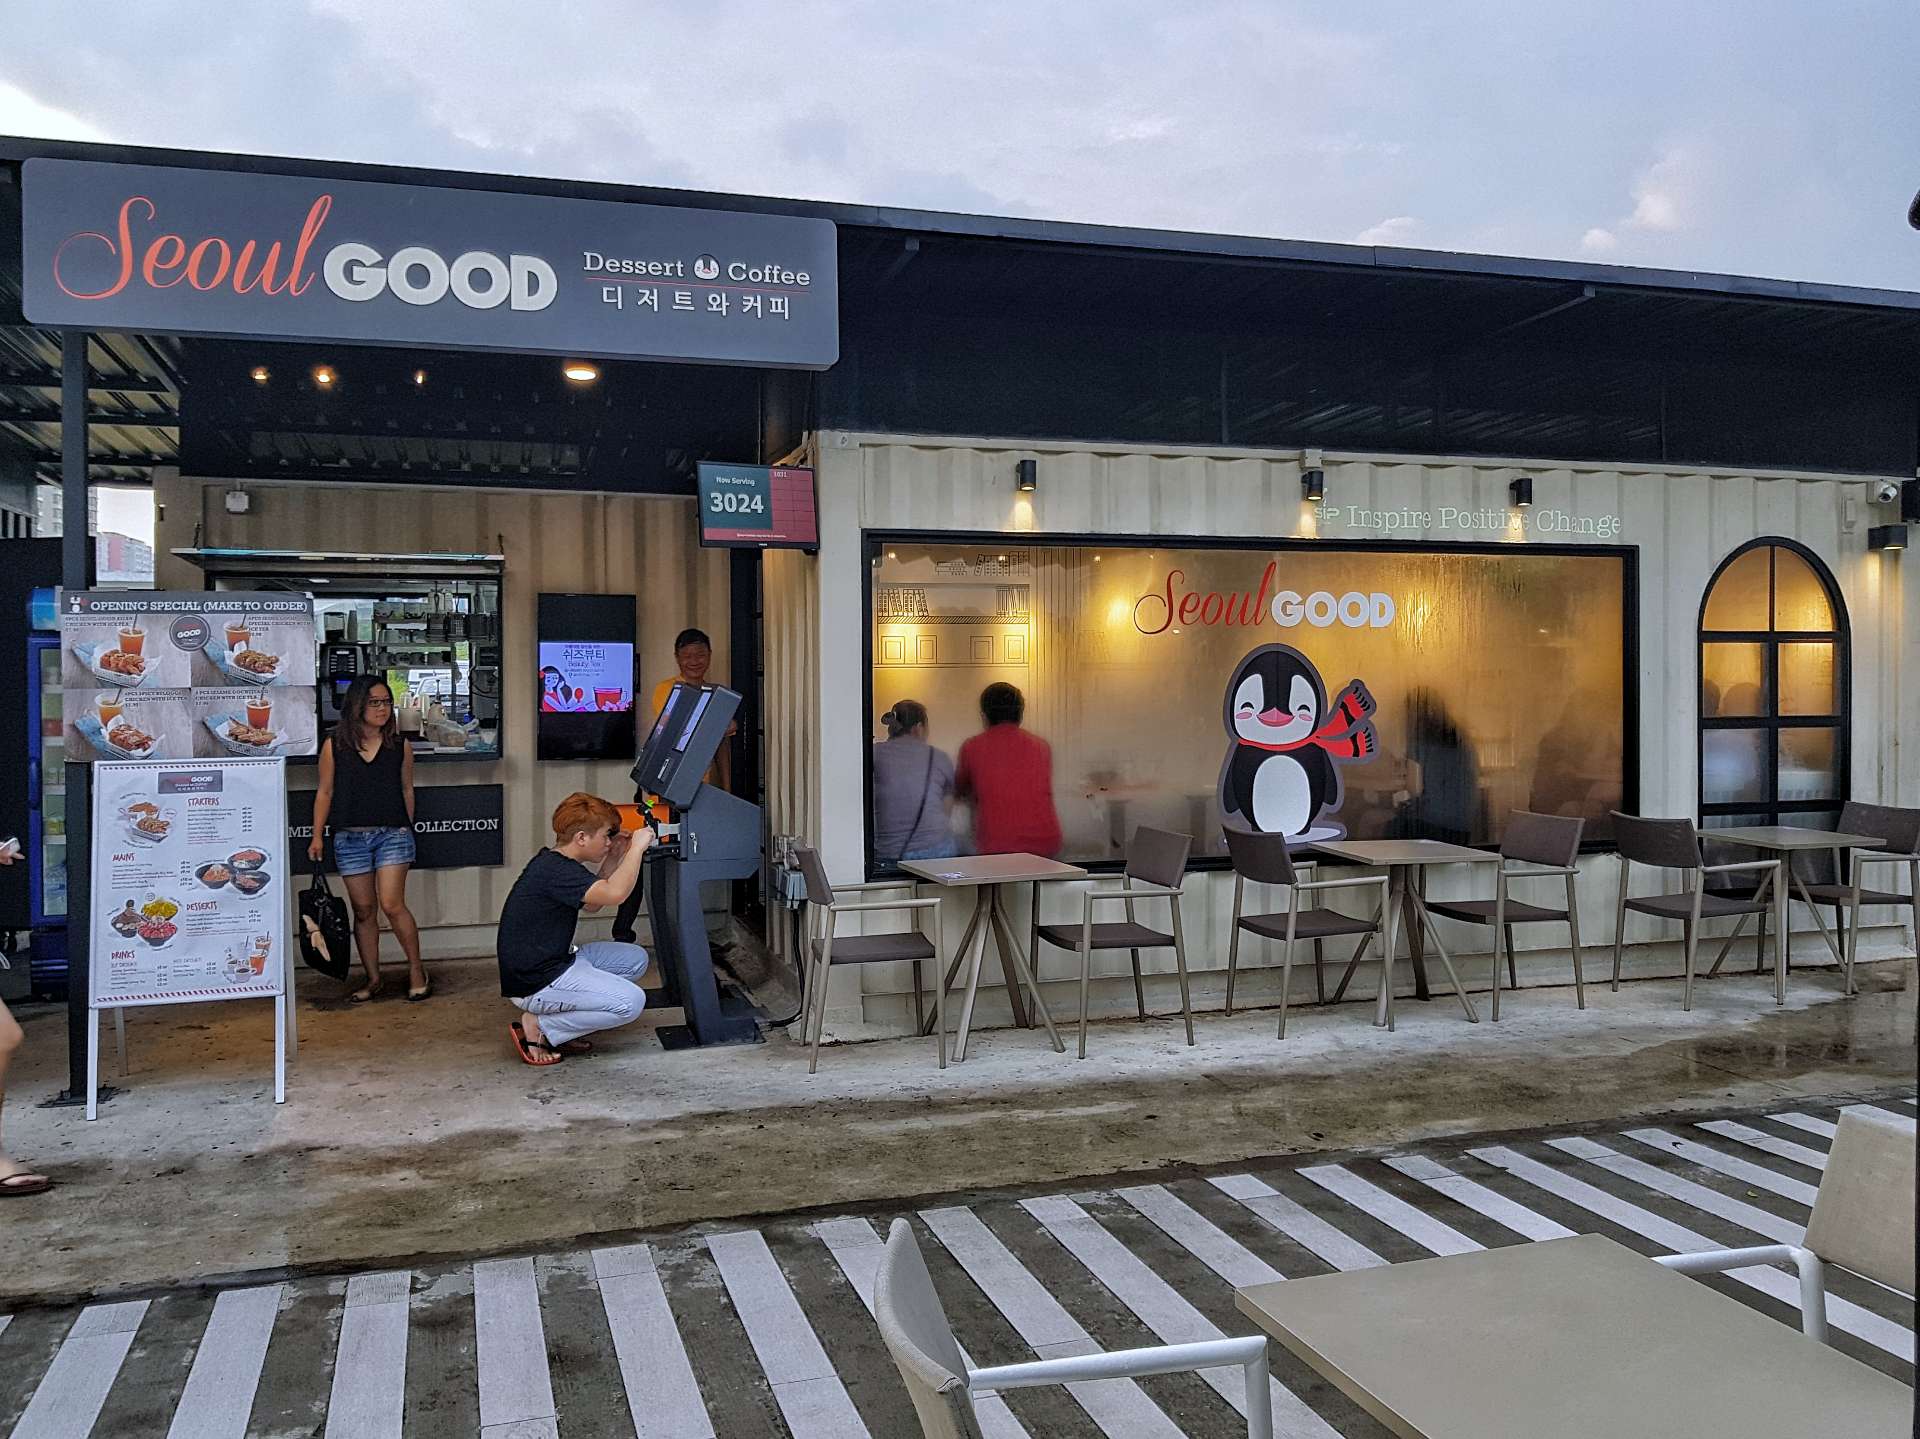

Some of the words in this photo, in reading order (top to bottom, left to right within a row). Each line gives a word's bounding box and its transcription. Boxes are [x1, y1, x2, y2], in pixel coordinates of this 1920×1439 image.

[54, 195, 332, 299] Seoul
[323, 242, 558, 311] GOOD
[583, 251, 684, 277] Dessert
[728, 262, 811, 286] Coffee
[732, 477, 755, 486] Serving
[710, 492, 764, 514] 3024
[1346, 505, 1432, 534] Inspire
[1438, 506, 1530, 531] Positive
[1536, 509, 1622, 538] Change
[90, 601, 147, 612] OPENING
[150, 601, 200, 612] SPECIAL
[203, 601, 242, 612] (MAKE
[244, 601, 260, 612] TO
[263, 601, 308, 612] ORDER)
[1133, 561, 1277, 634] Seoul
[1271, 590, 1395, 628] GOOD
[177, 628, 201, 638] GOOD
[414, 818, 499, 833] OLLECTION
[111, 950, 135, 960] DRINKS
